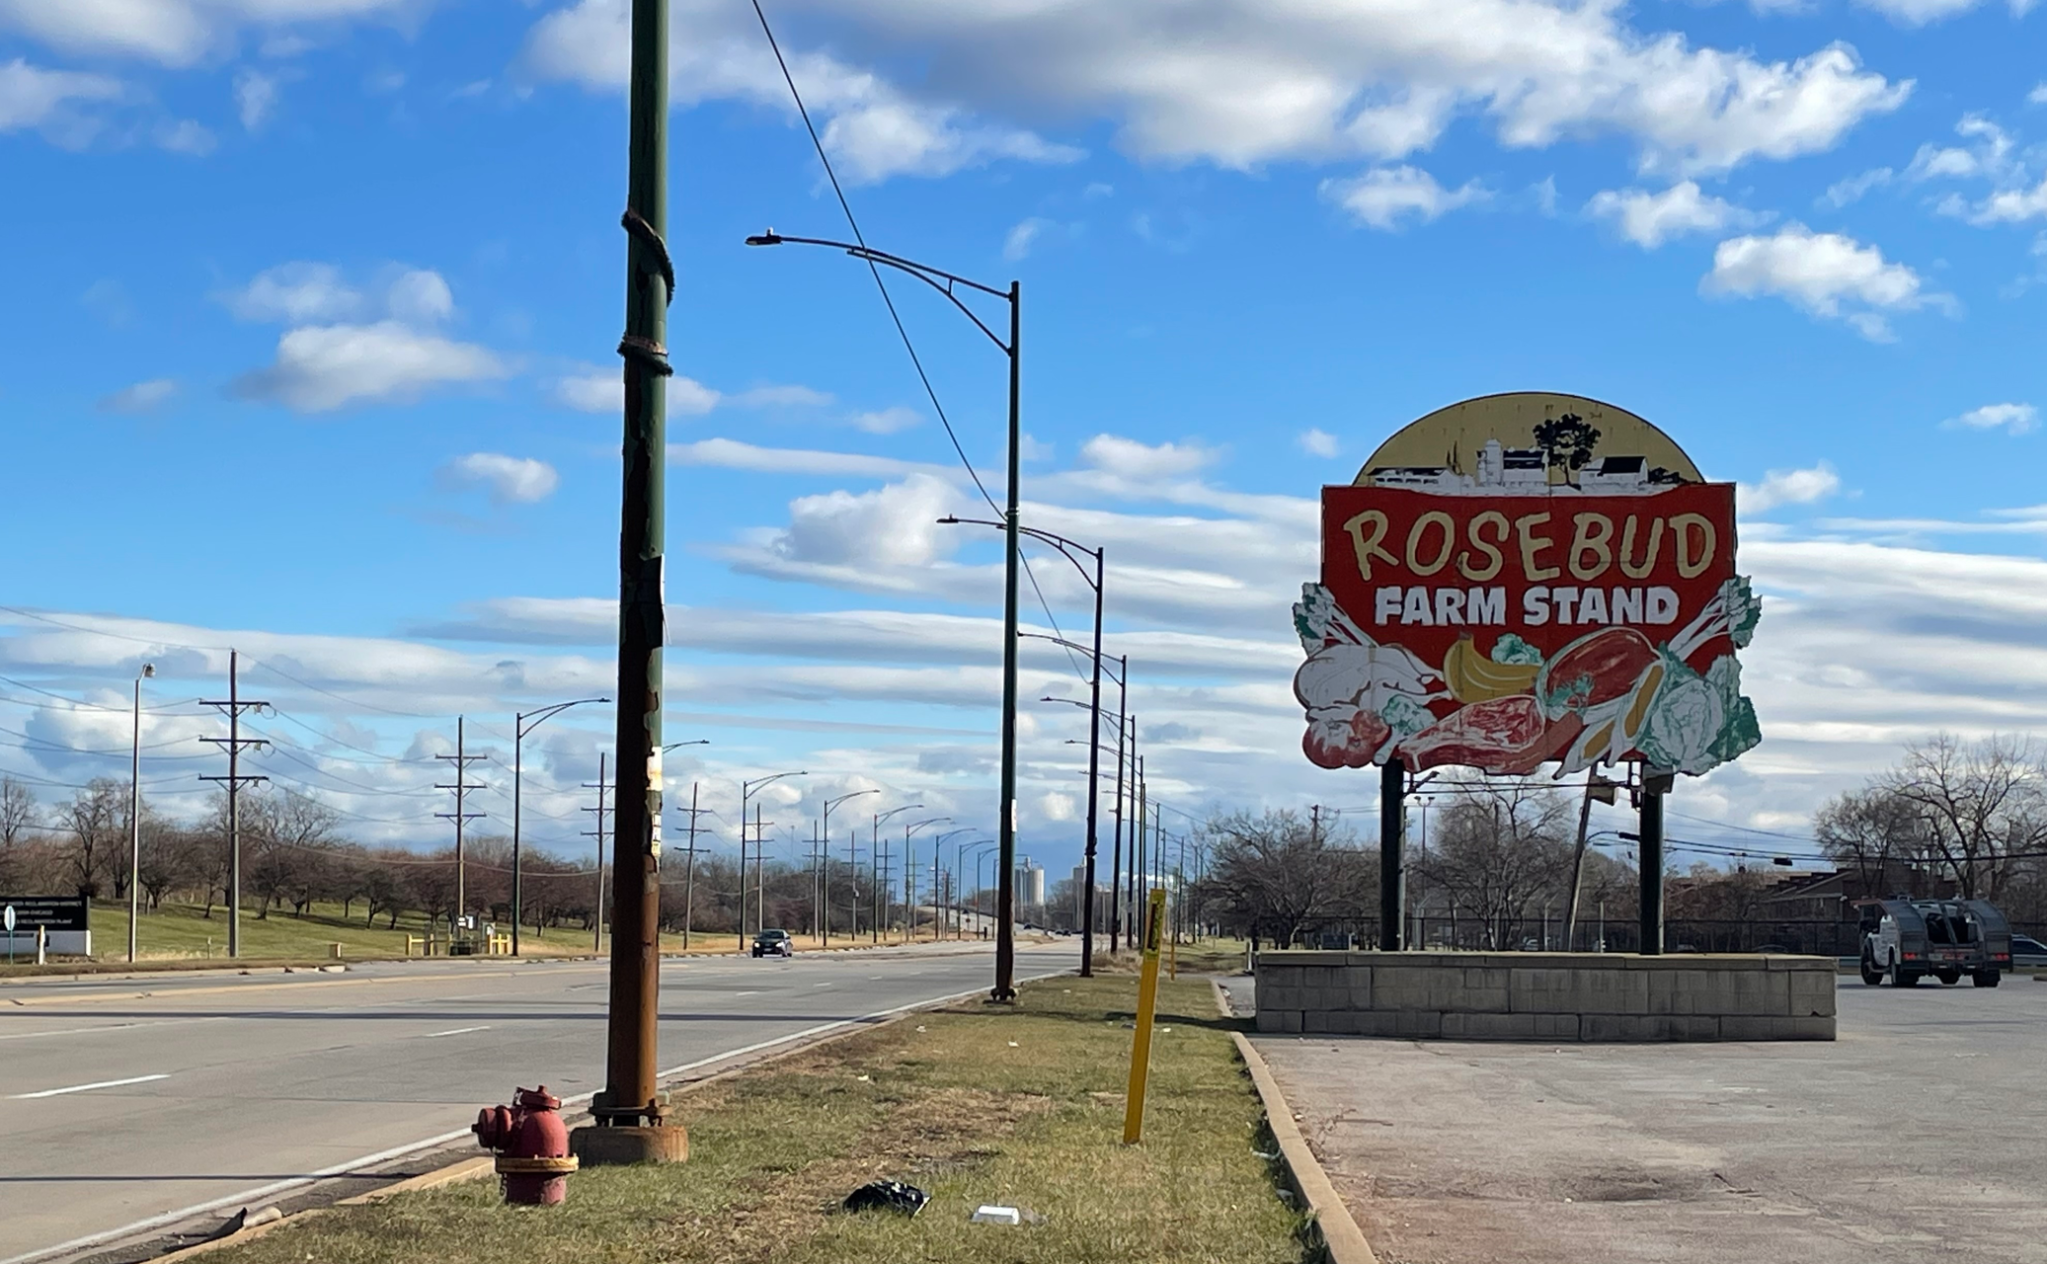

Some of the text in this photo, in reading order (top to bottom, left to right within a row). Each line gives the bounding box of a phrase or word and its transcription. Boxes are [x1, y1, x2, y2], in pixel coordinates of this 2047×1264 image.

[1343, 509, 1716, 581] ROSEBUD
[1375, 585, 1680, 626] FARM STAND
